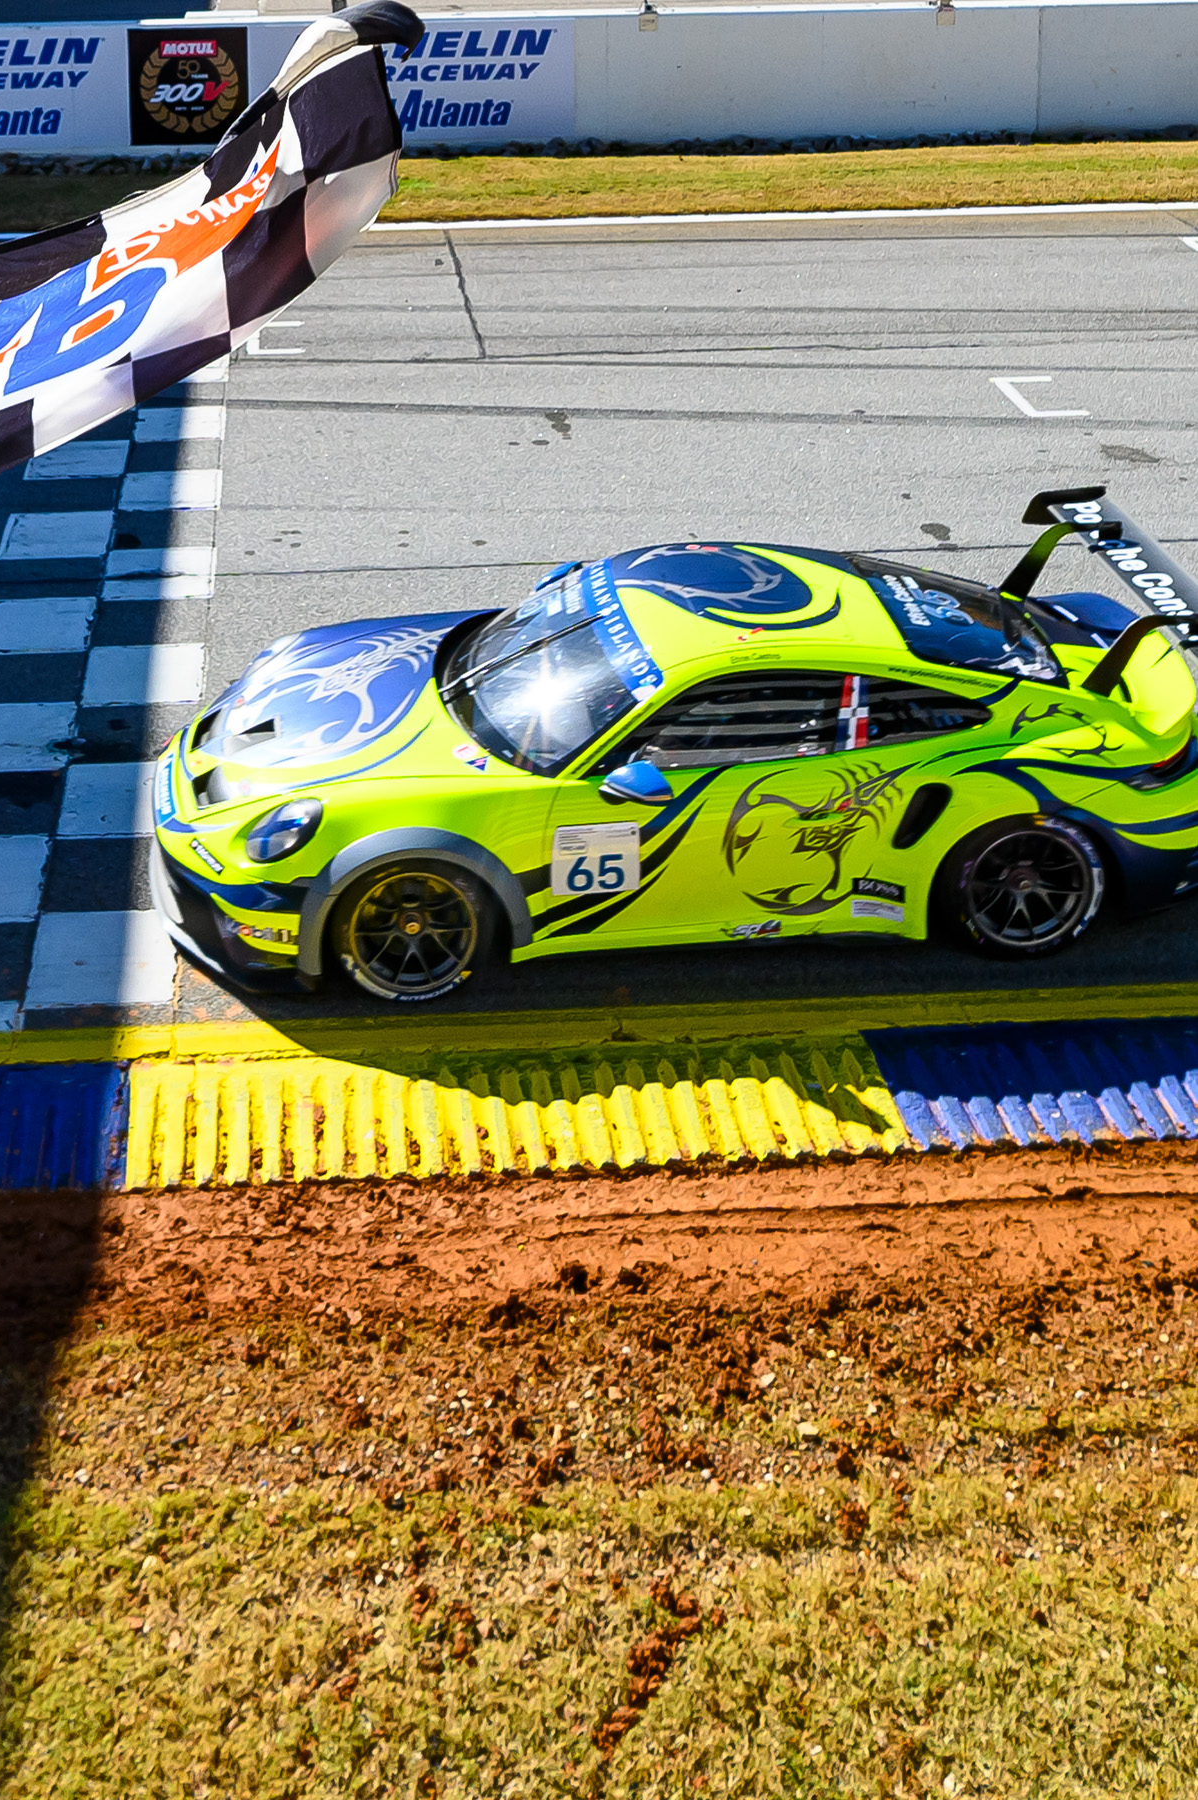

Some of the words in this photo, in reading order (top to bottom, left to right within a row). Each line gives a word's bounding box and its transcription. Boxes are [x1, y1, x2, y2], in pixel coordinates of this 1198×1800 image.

[162, 42, 215, 55] MOTUL
[177, 59, 201, 80] 50
[149, 81, 231, 104] 300V
[399, 88, 513, 132] Atlanta
[566, 853, 625, 892] 65
